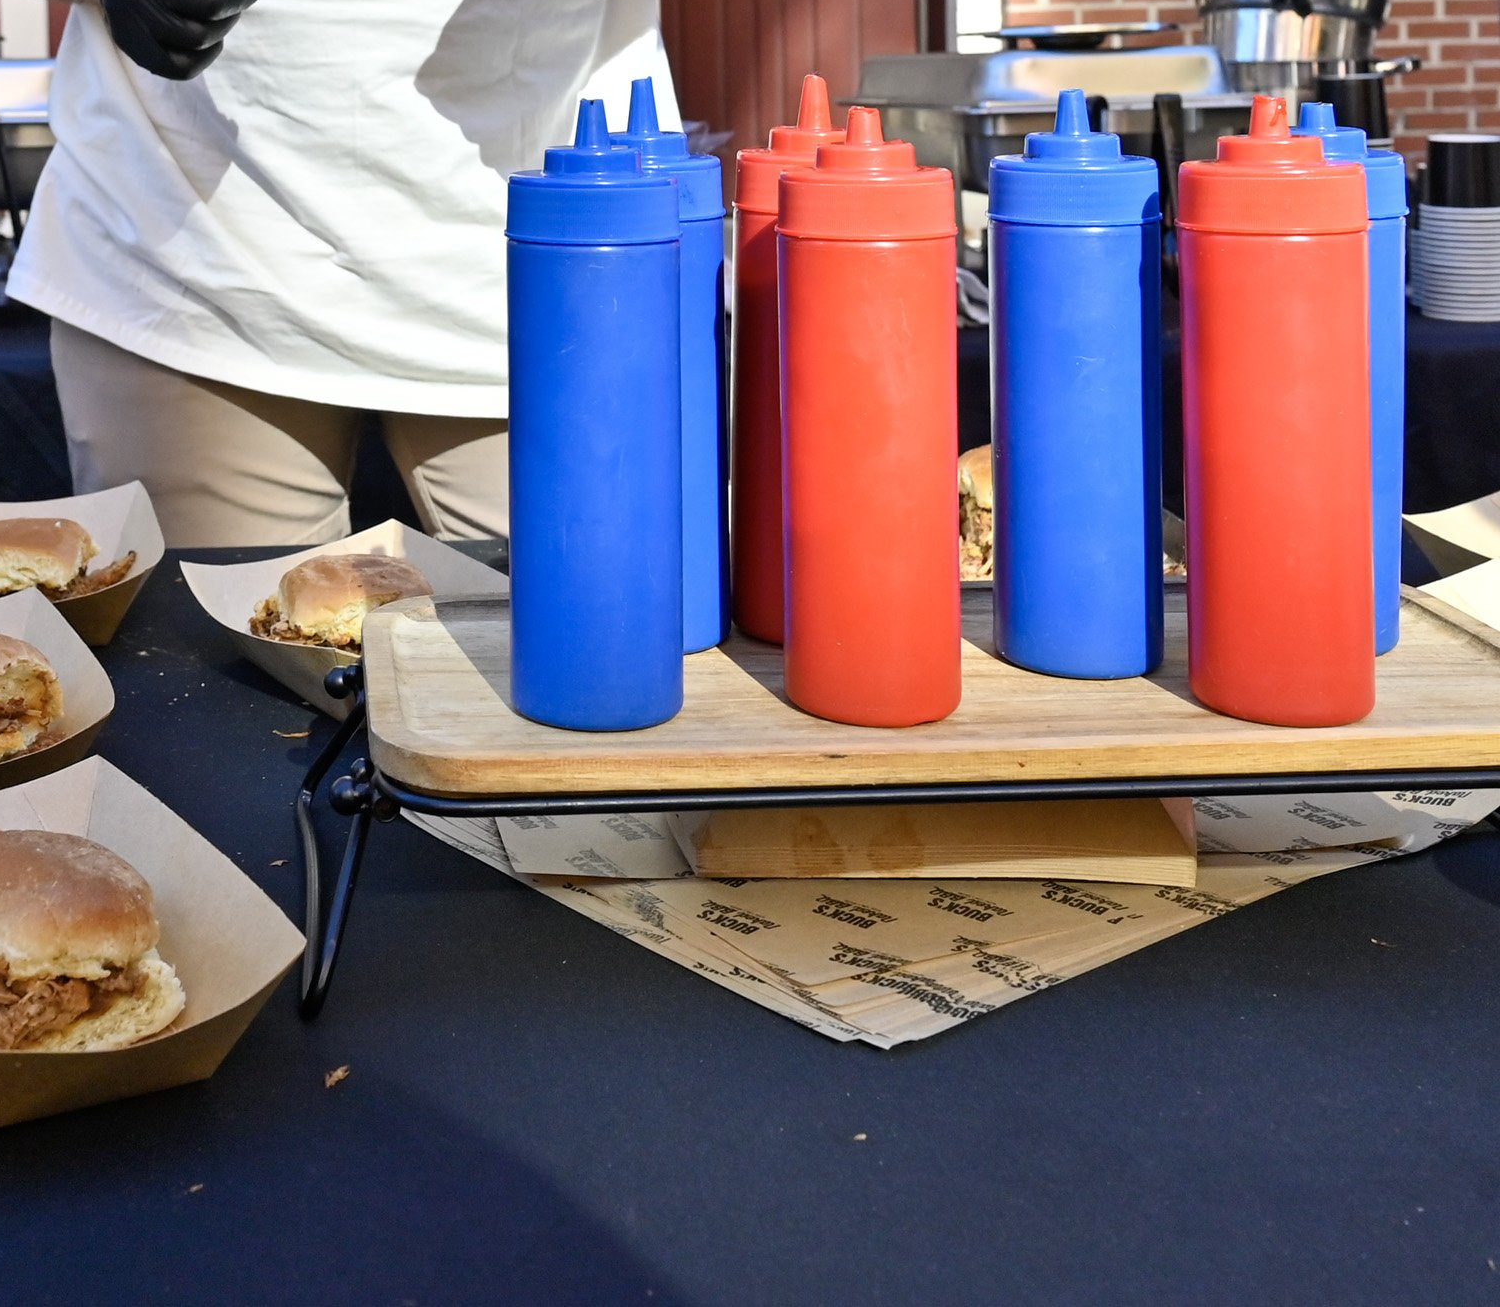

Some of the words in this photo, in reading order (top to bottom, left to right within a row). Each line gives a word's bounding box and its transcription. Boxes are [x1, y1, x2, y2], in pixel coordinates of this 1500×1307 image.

[1392, 793, 1456, 807] BUCK'S
[1288, 807, 1346, 830] BUCK'S
[815, 894, 850, 909] BBQ
[929, 886, 966, 903] BBQ
[1041, 890, 1110, 916] BUCK'S
[1079, 890, 1130, 912] Naked
[701, 899, 736, 914] BBQ
[812, 904, 877, 929] BUCK'S
[850, 903, 898, 924] Naked
[927, 897, 994, 923] BUCK'S
[965, 896, 1015, 918] Naked
[696, 909, 760, 935] BUCK'S
[735, 911, 781, 931] Naked
